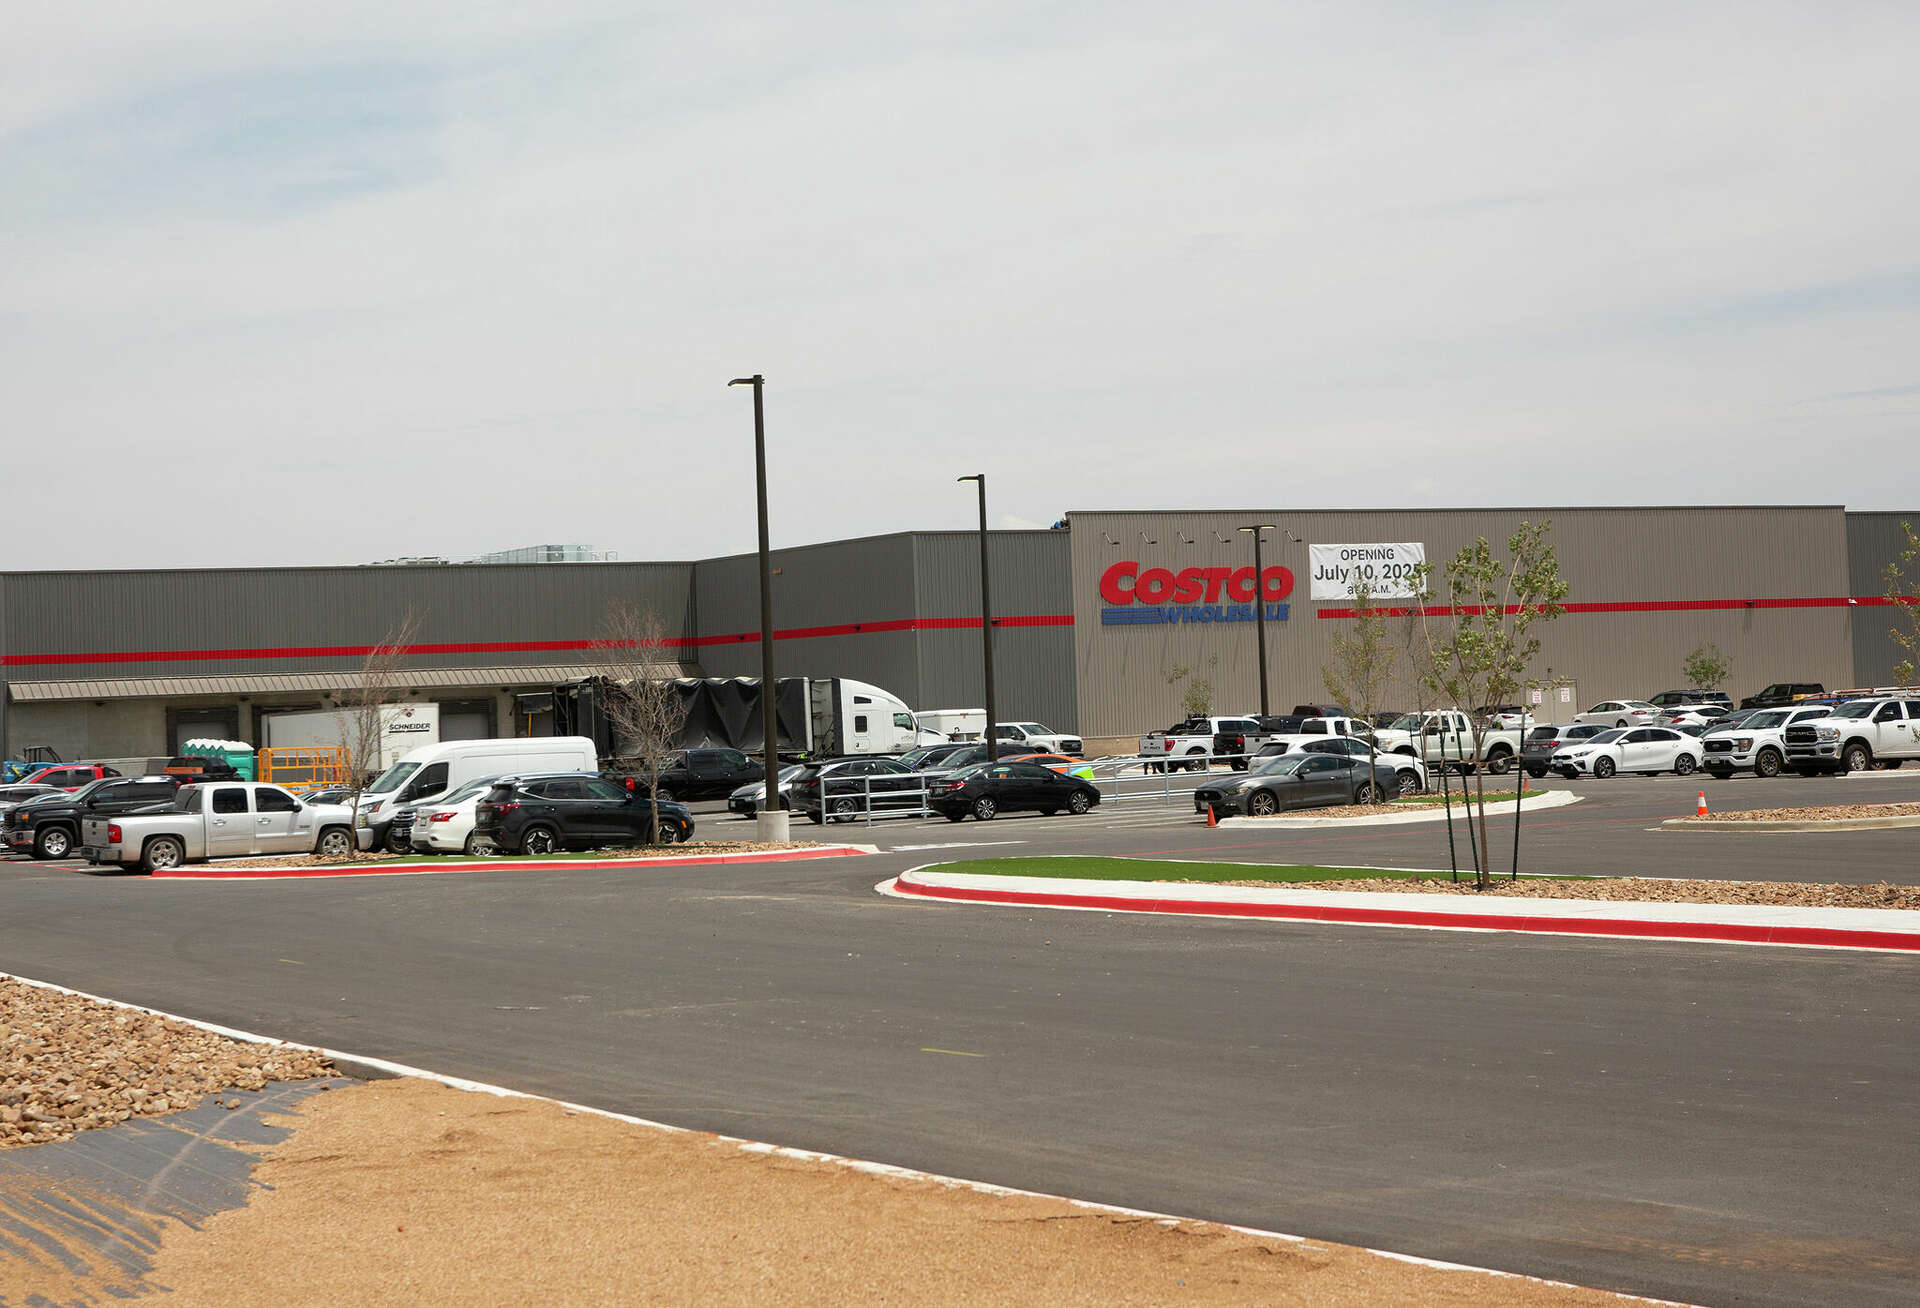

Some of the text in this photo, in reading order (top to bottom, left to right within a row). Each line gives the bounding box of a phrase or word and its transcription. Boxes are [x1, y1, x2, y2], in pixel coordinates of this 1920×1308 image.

[1340, 548, 1394, 560] OPENING
[1314, 565, 1349, 584] July
[1354, 564, 1378, 581] 10,
[1100, 561, 1294, 605] COSTCO
[1371, 585, 1391, 594] A.M.
